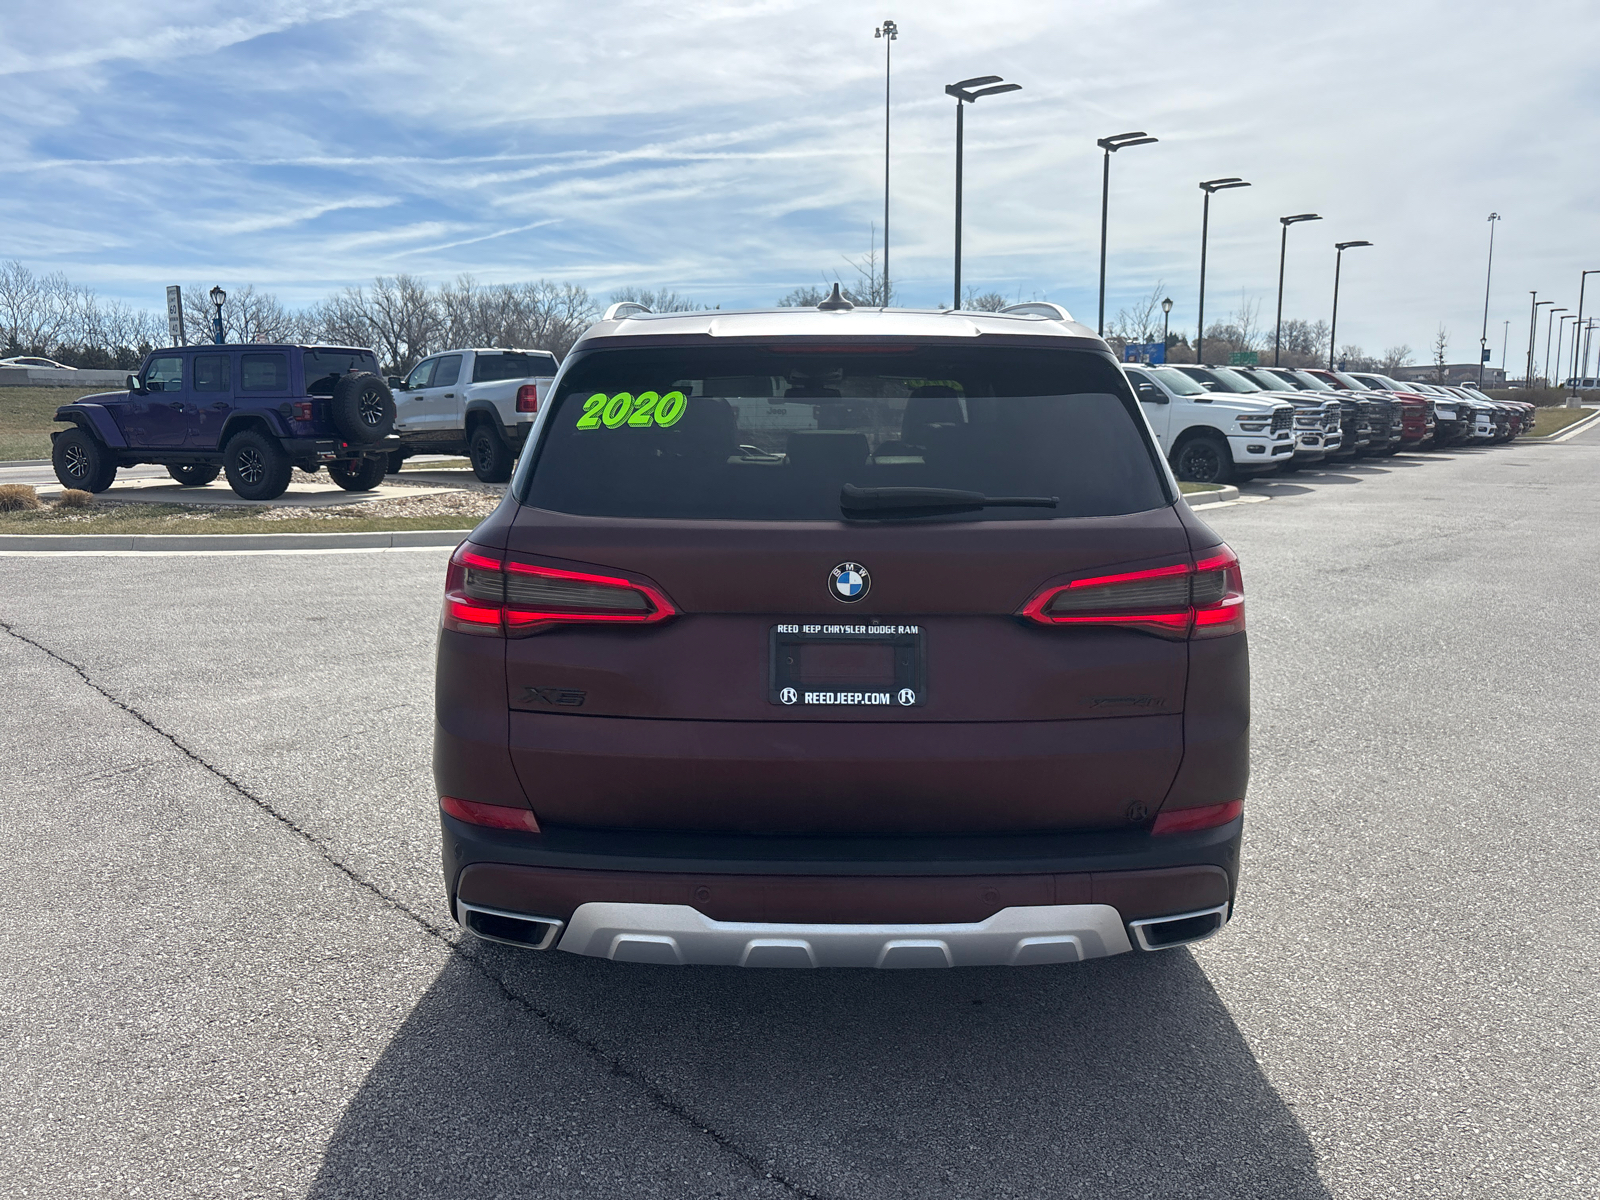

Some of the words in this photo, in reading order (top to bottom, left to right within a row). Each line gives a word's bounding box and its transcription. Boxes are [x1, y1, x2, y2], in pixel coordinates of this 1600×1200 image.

[576, 391, 687, 430] 2020
[832, 564, 867, 578] BMW
[777, 624, 798, 633] REED
[802, 624, 821, 634] JEEP
[823, 625, 866, 634] CHRYSLER
[868, 625, 896, 634] DODGE
[898, 625, 918, 634] RAM
[804, 692, 890, 705] REEDJEEP.COM
